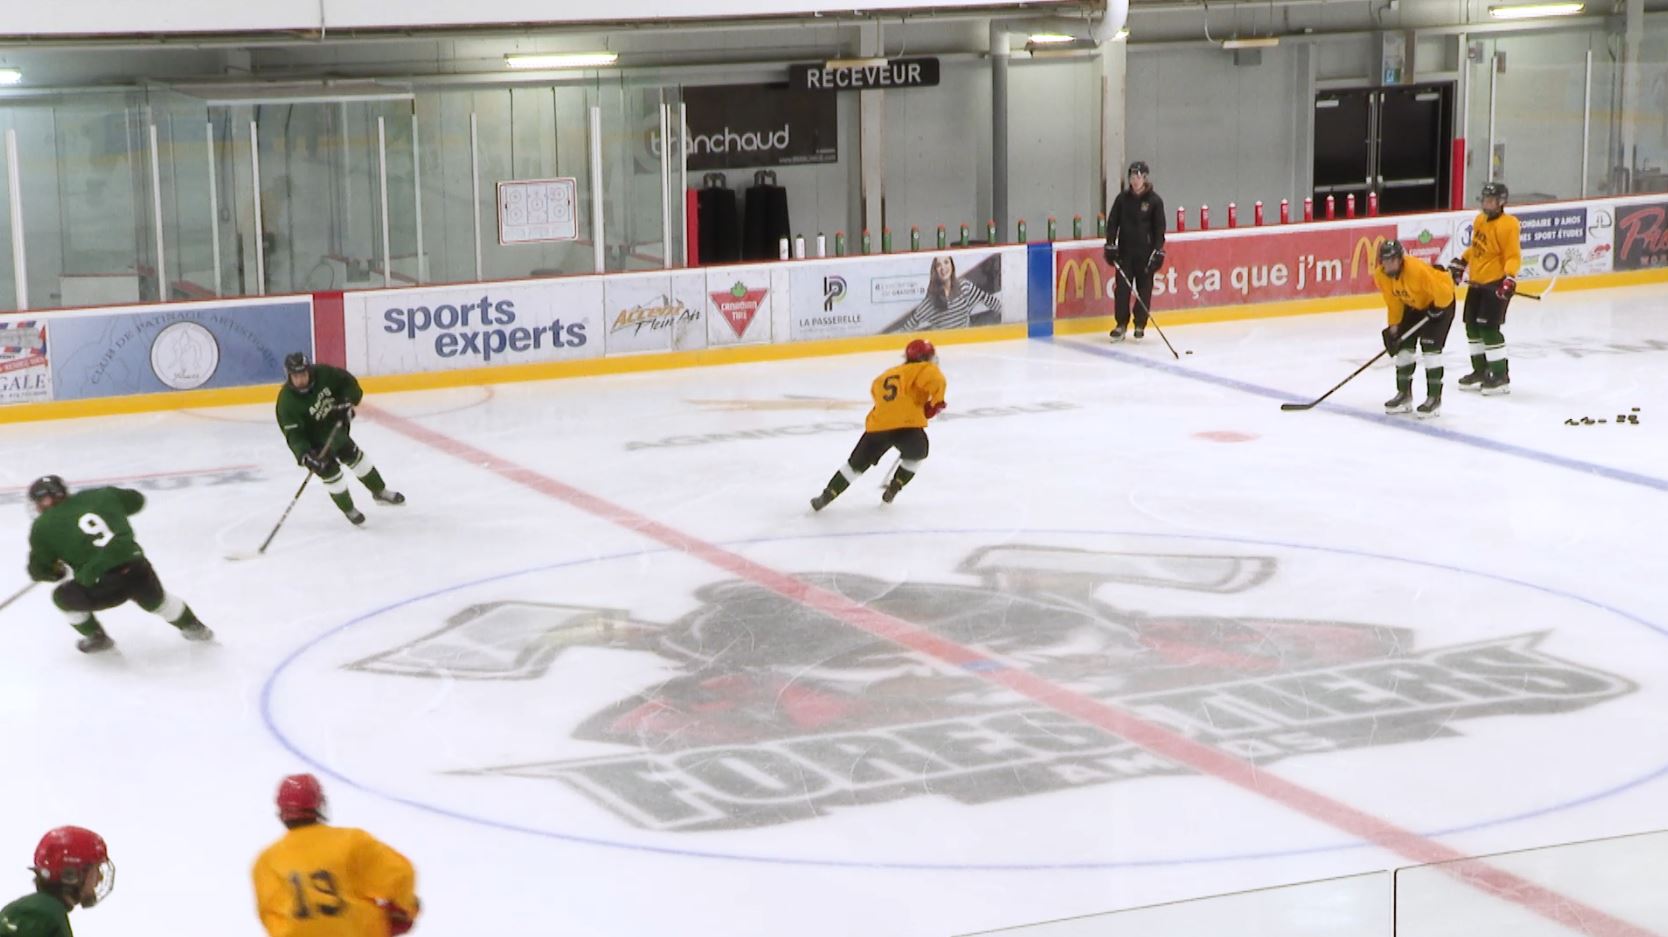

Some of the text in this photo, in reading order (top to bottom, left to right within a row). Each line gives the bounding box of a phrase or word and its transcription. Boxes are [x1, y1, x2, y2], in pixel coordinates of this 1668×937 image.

[807, 63, 922, 89] RECEVEUR
[1533, 230, 1556, 241] SPORT
[1187, 269, 1222, 298] ça
[1230, 262, 1289, 296] que
[383, 295, 516, 339] sports
[799, 314, 862, 328] LA PASSERELLE
[434, 318, 588, 362] experts
[883, 375, 900, 402] 5
[78, 512, 114, 547] 9
